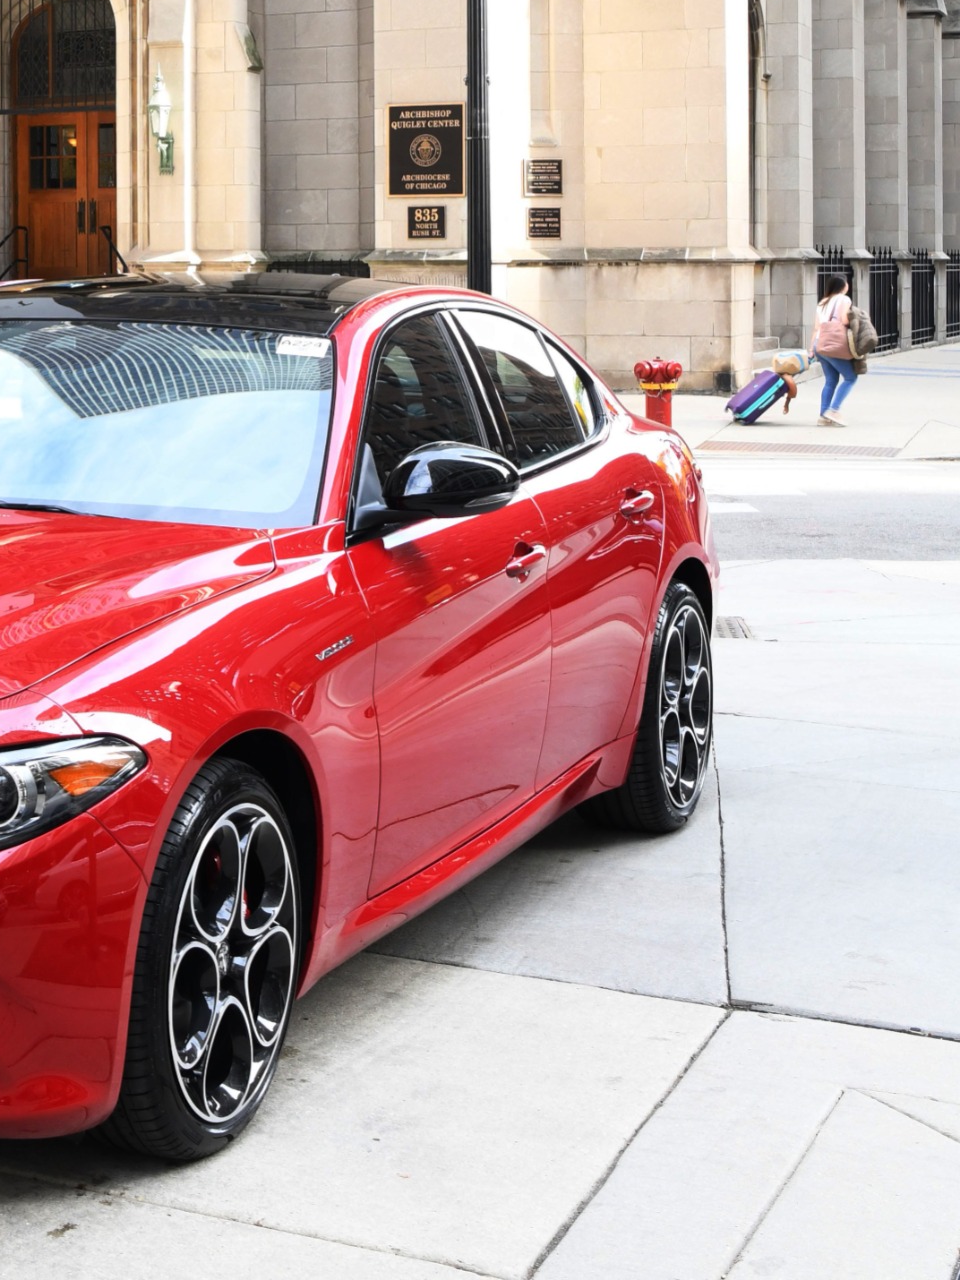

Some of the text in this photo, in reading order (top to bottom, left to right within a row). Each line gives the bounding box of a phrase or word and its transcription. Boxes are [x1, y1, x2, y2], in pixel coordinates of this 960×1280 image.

[399, 110, 451, 119] ARCHBISHOP
[391, 119, 460, 130] QUIGLEY CENTER
[401, 174, 451, 182] ARCHDIOCESE
[405, 182, 447, 190] OF CHICAGO
[414, 208, 439, 222] 835
[415, 222, 438, 230] NORTH
